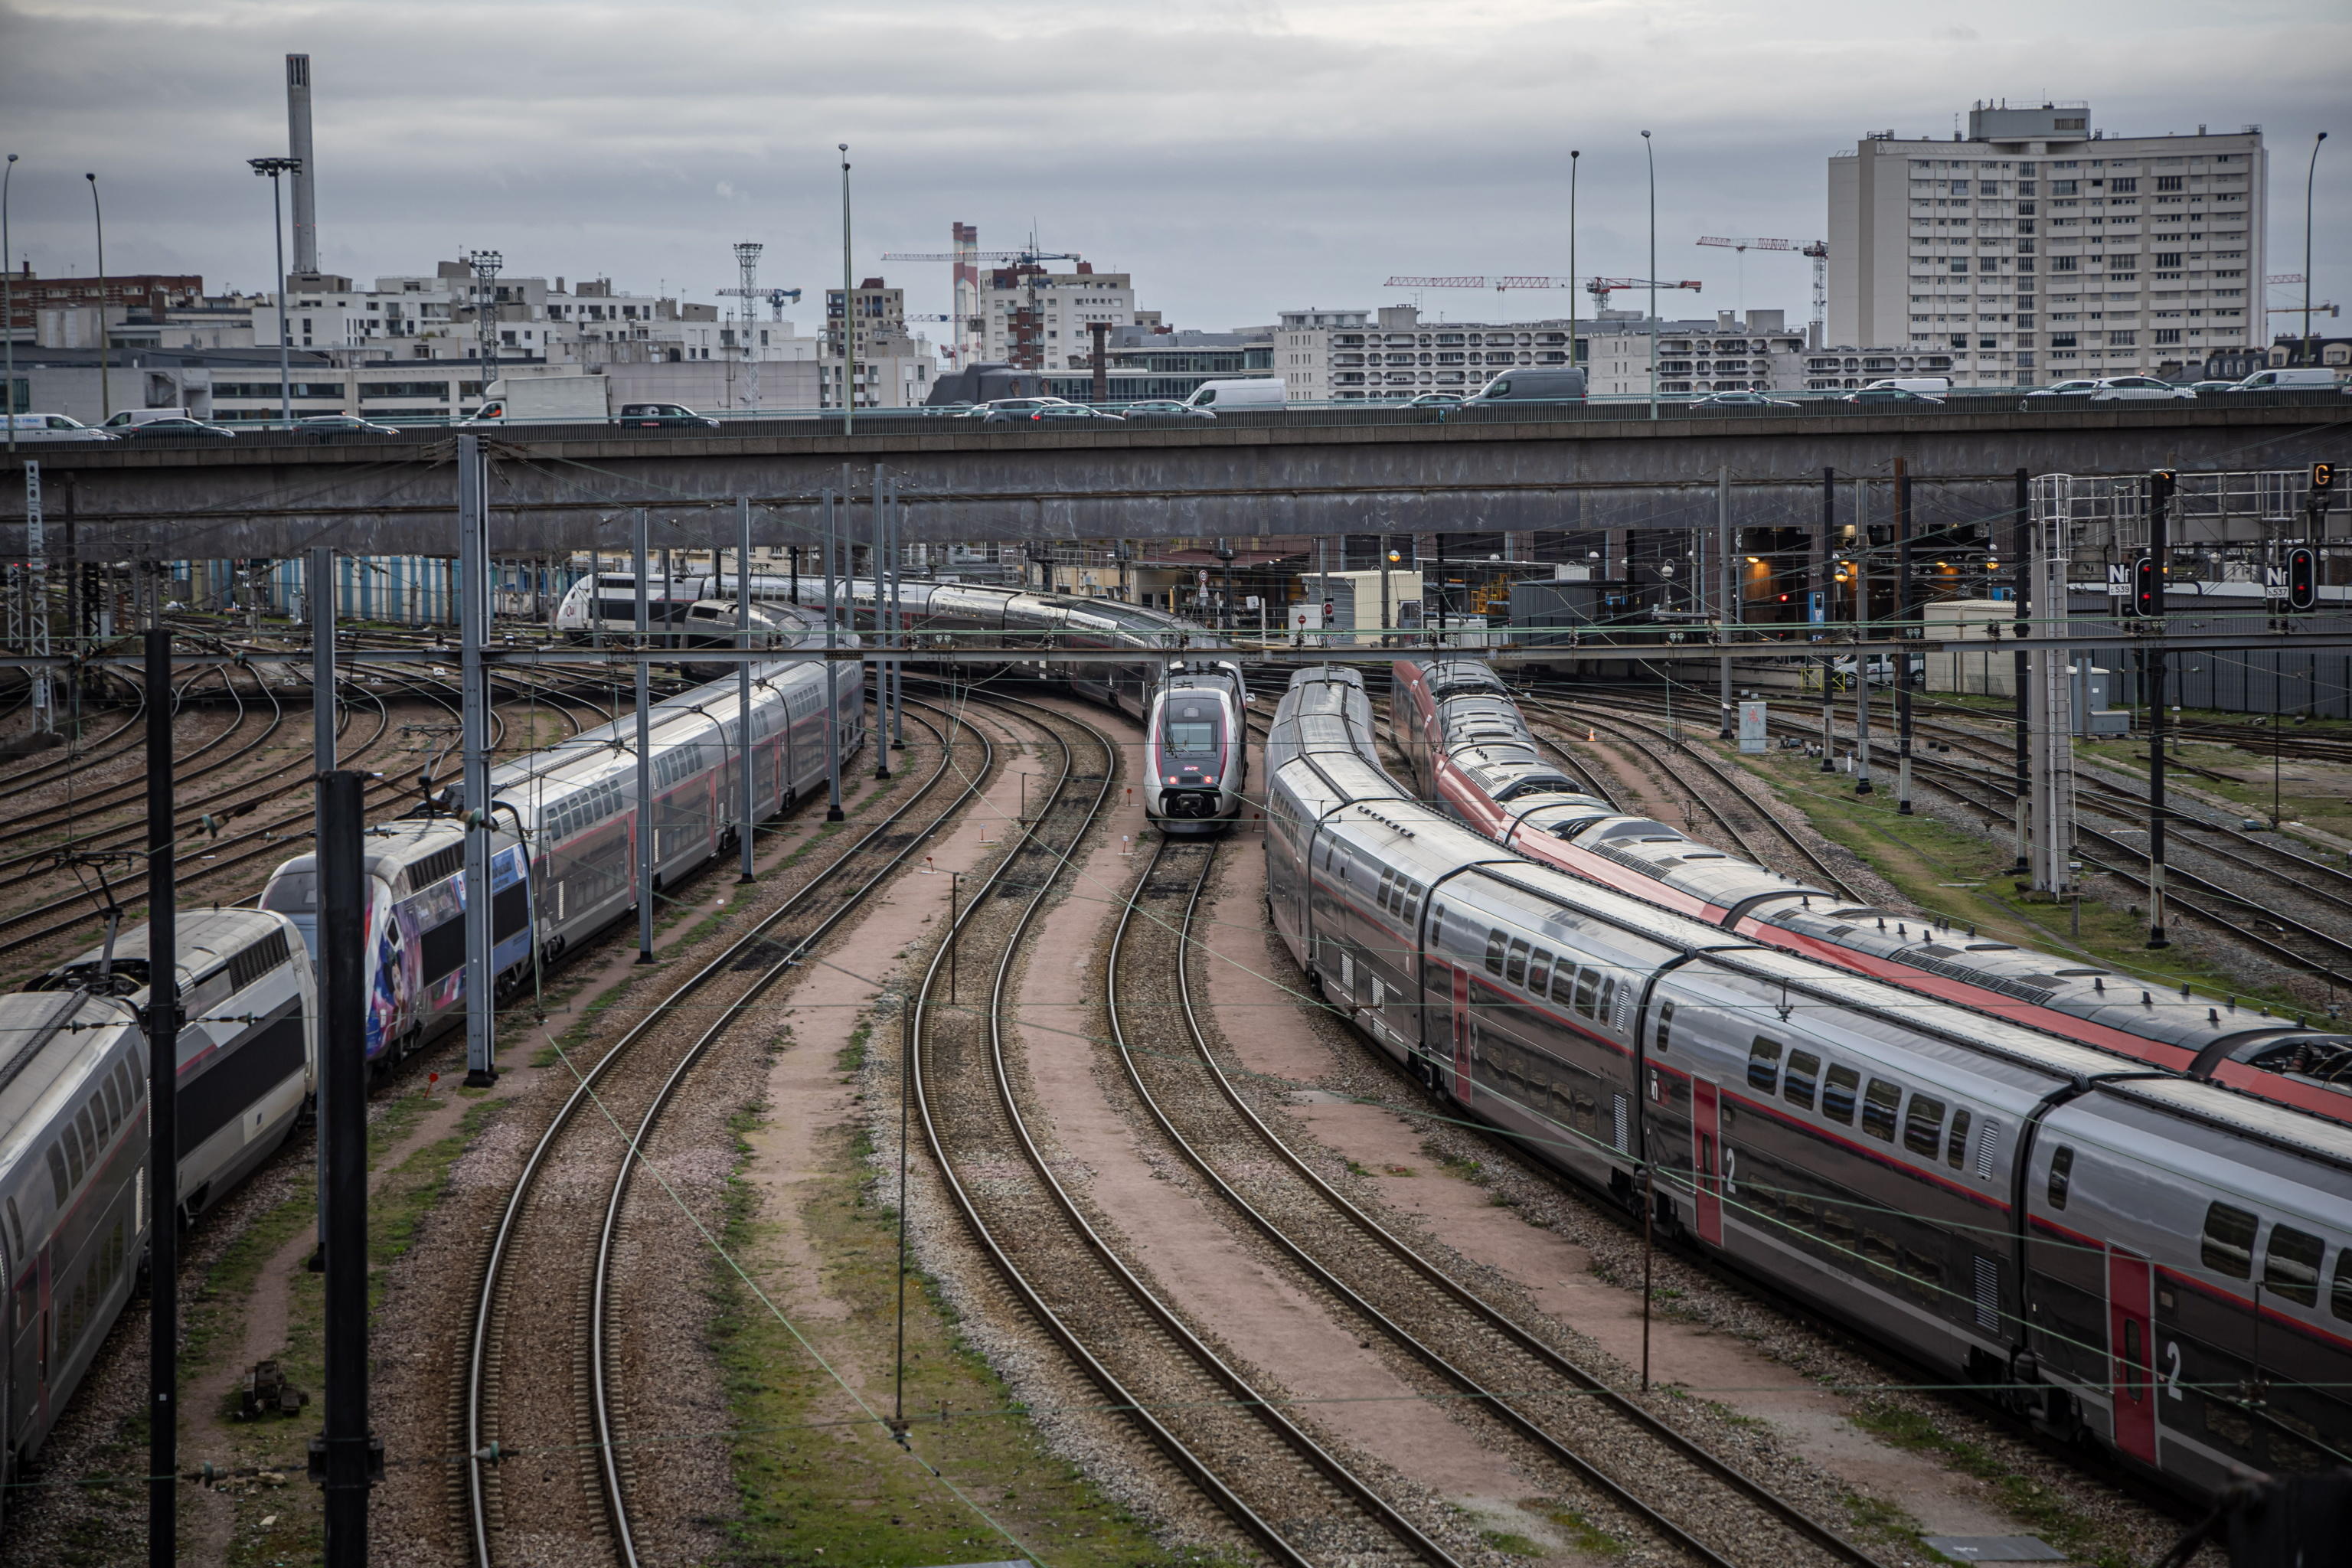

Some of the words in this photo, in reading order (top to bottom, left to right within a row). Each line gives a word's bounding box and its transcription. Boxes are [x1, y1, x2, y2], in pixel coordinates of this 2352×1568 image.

[2109, 564, 2131, 583] Nf
[2267, 567, 2288, 586] Nf
[1726, 1148, 1736, 1194] 2
[2167, 1341, 2183, 1401] 2
